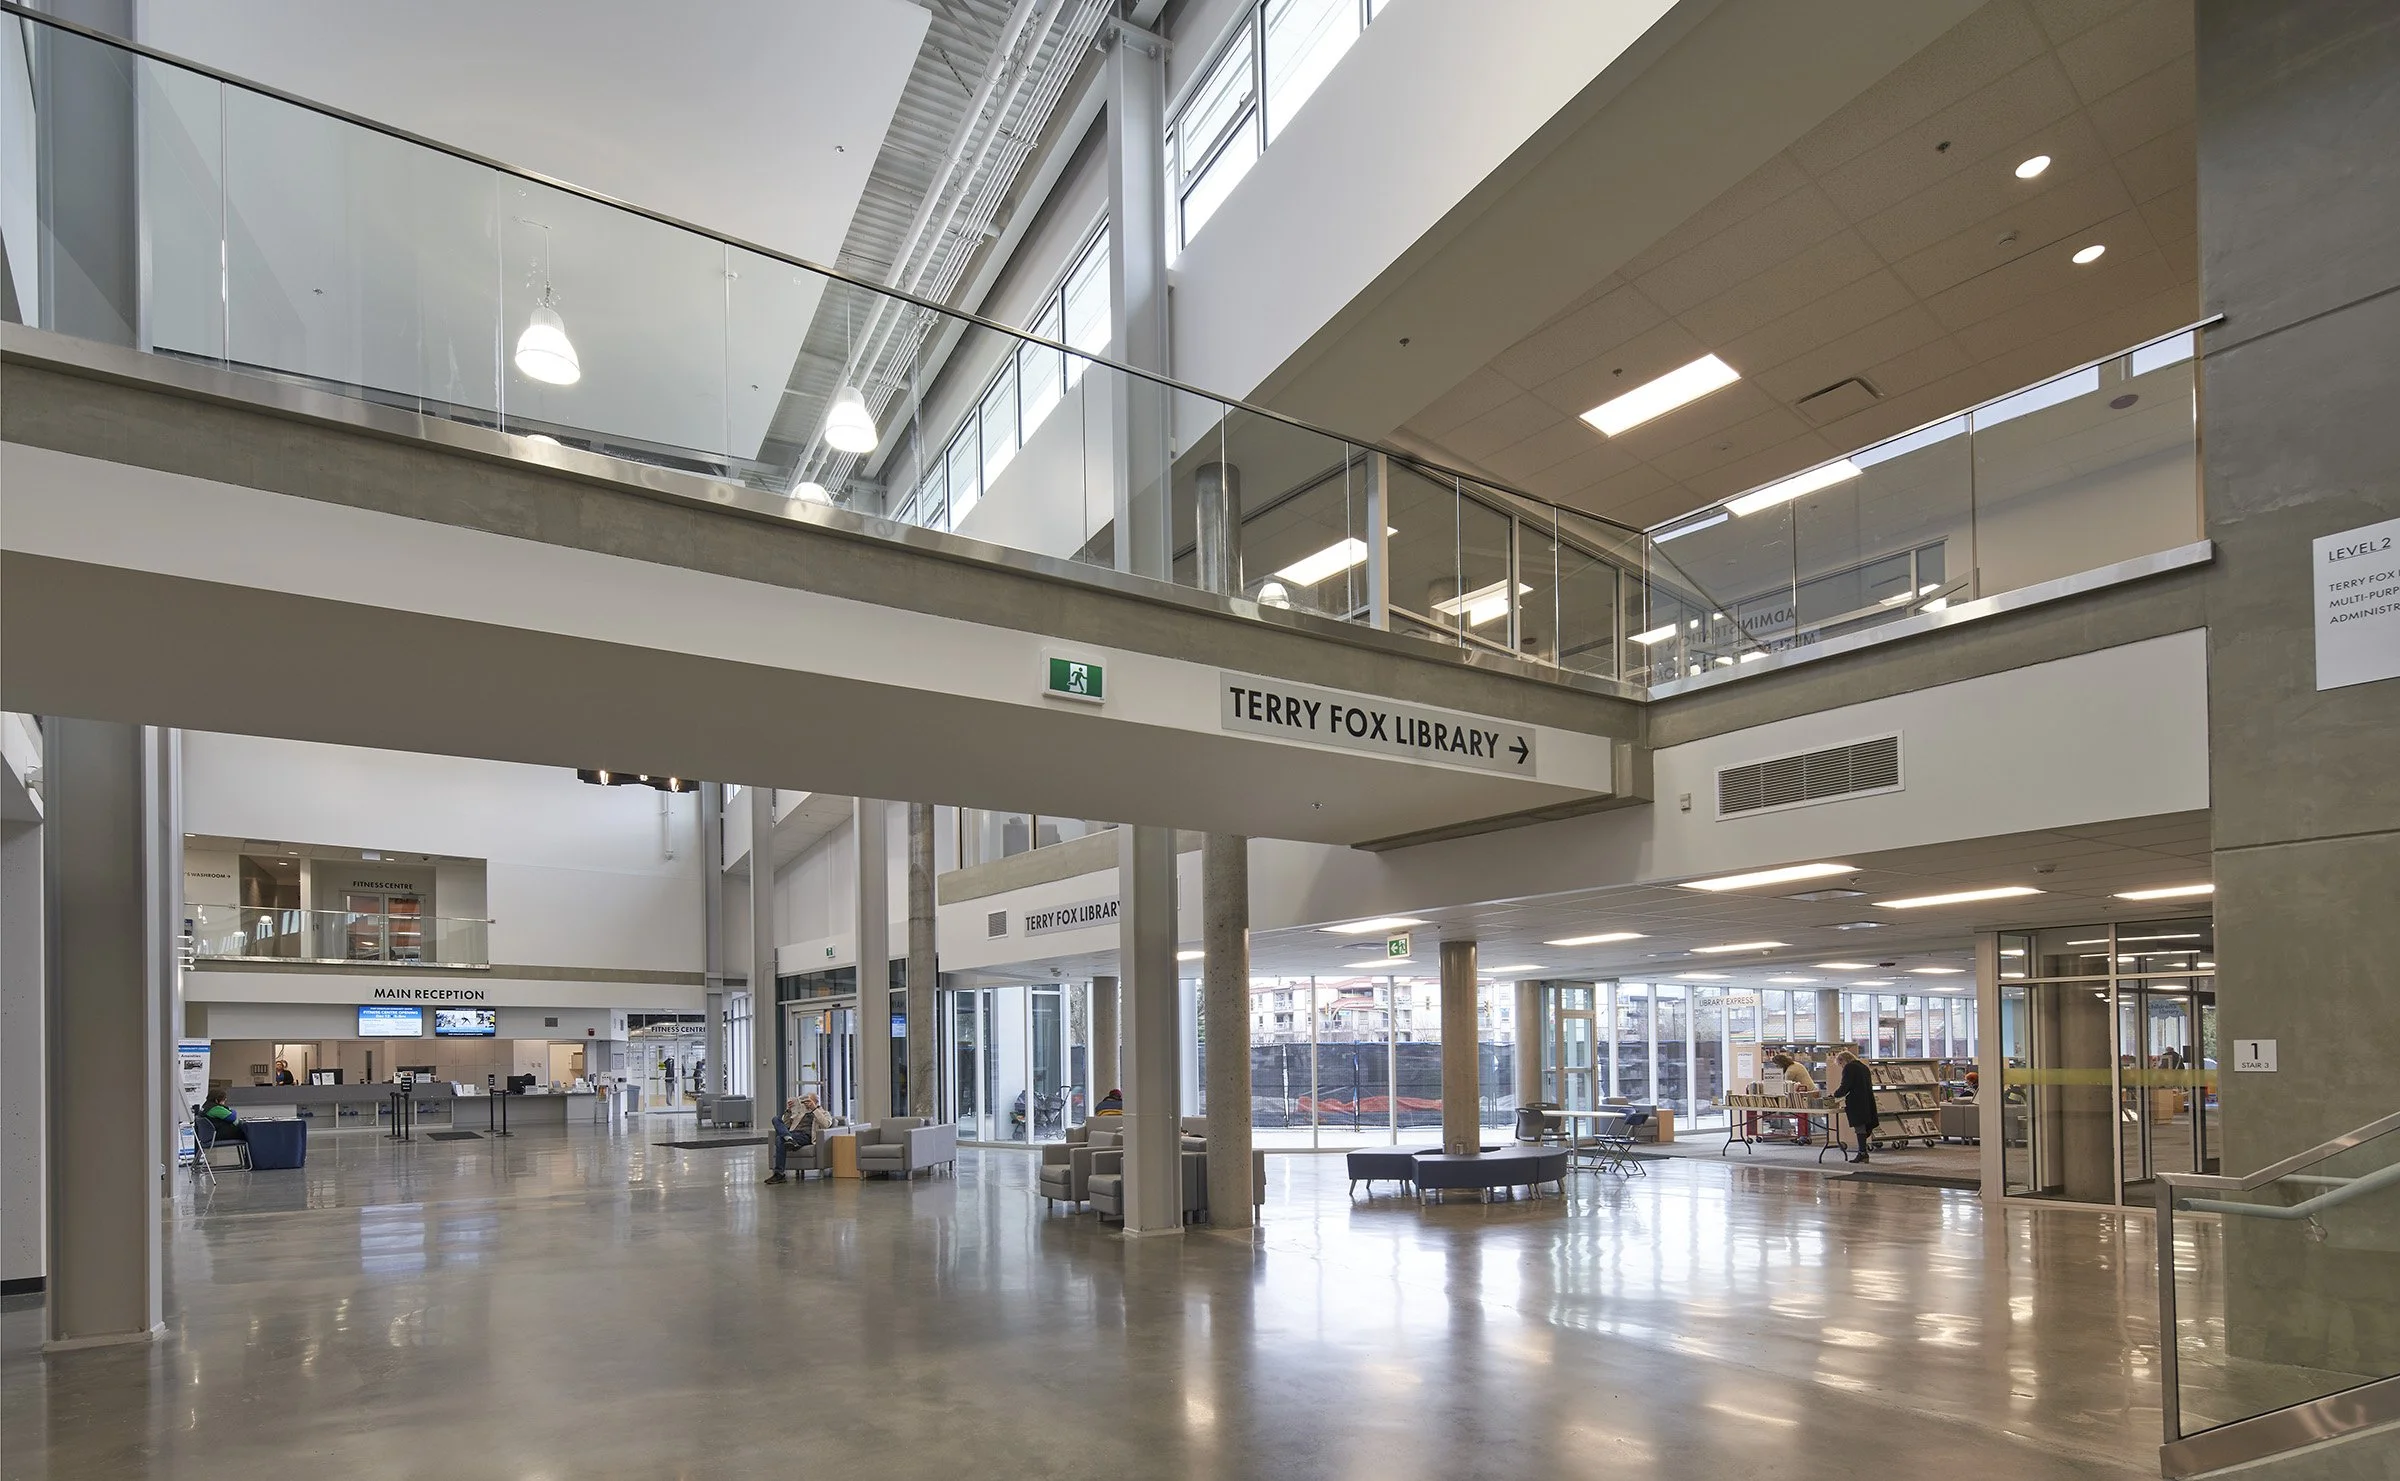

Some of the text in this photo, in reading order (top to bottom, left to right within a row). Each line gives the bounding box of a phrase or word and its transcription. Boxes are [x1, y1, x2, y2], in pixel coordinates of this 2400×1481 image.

[2329, 537, 2391, 561] LEVEL 2
[2329, 577, 2366, 592] TERRY
[2368, 570, 2395, 583] FOX
[2329, 586, 2400, 608] MULTI-PURP
[2329, 602, 2400, 624] ADMINISTR
[1229, 686, 1499, 759] TERRY FOX LIBRARY
[353, 881, 383, 889] FITNESS
[1025, 912, 1054, 931] TERRY
[1056, 908, 1078, 926] FOX
[374, 988, 485, 1000] MAIN RECEPTION
[1700, 996, 1754, 1006] LIBRARY EXPRESS
[2250, 1043, 2259, 1060] 1
